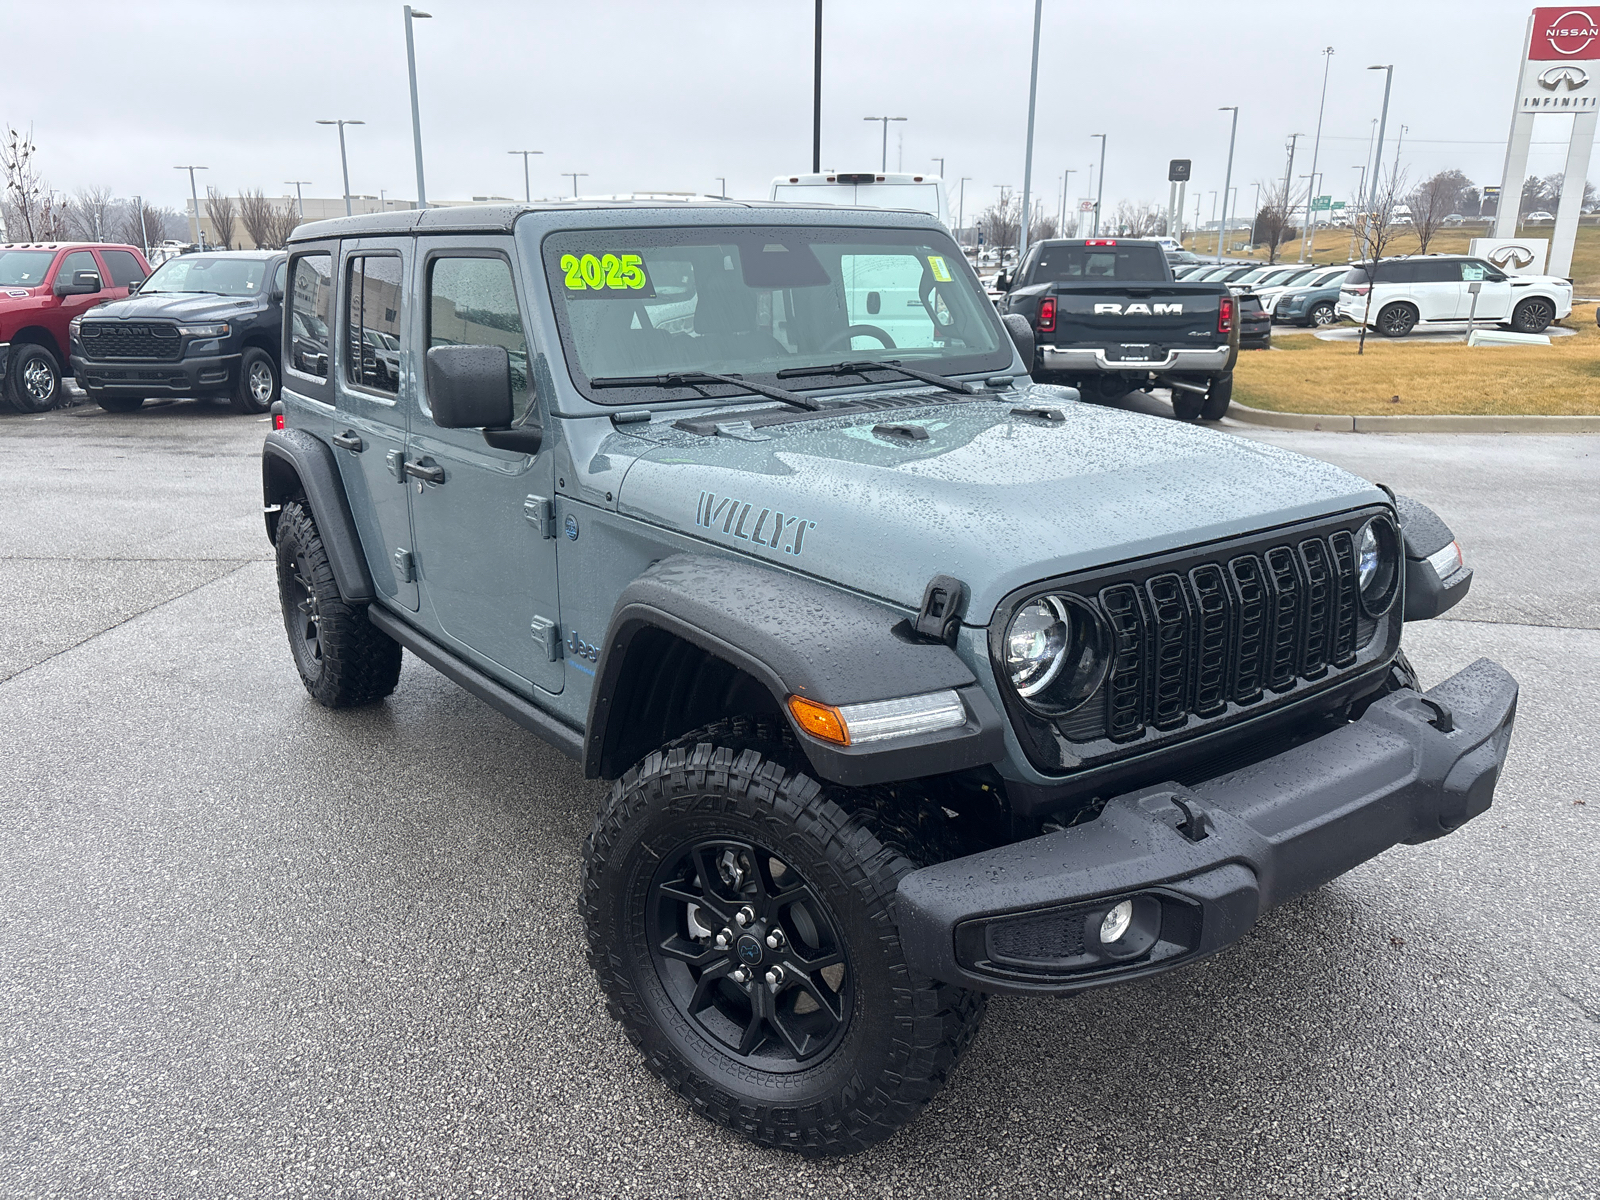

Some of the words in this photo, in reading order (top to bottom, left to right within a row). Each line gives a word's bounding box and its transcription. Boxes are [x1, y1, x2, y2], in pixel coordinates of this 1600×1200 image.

[1546, 28, 1599, 37] NISSAN
[1523, 97, 1597, 107] INFINITI
[560, 253, 646, 290] 2025
[1094, 303, 1183, 316] RAM
[102, 327, 150, 335] RAM
[696, 490, 817, 556] WILLYS
